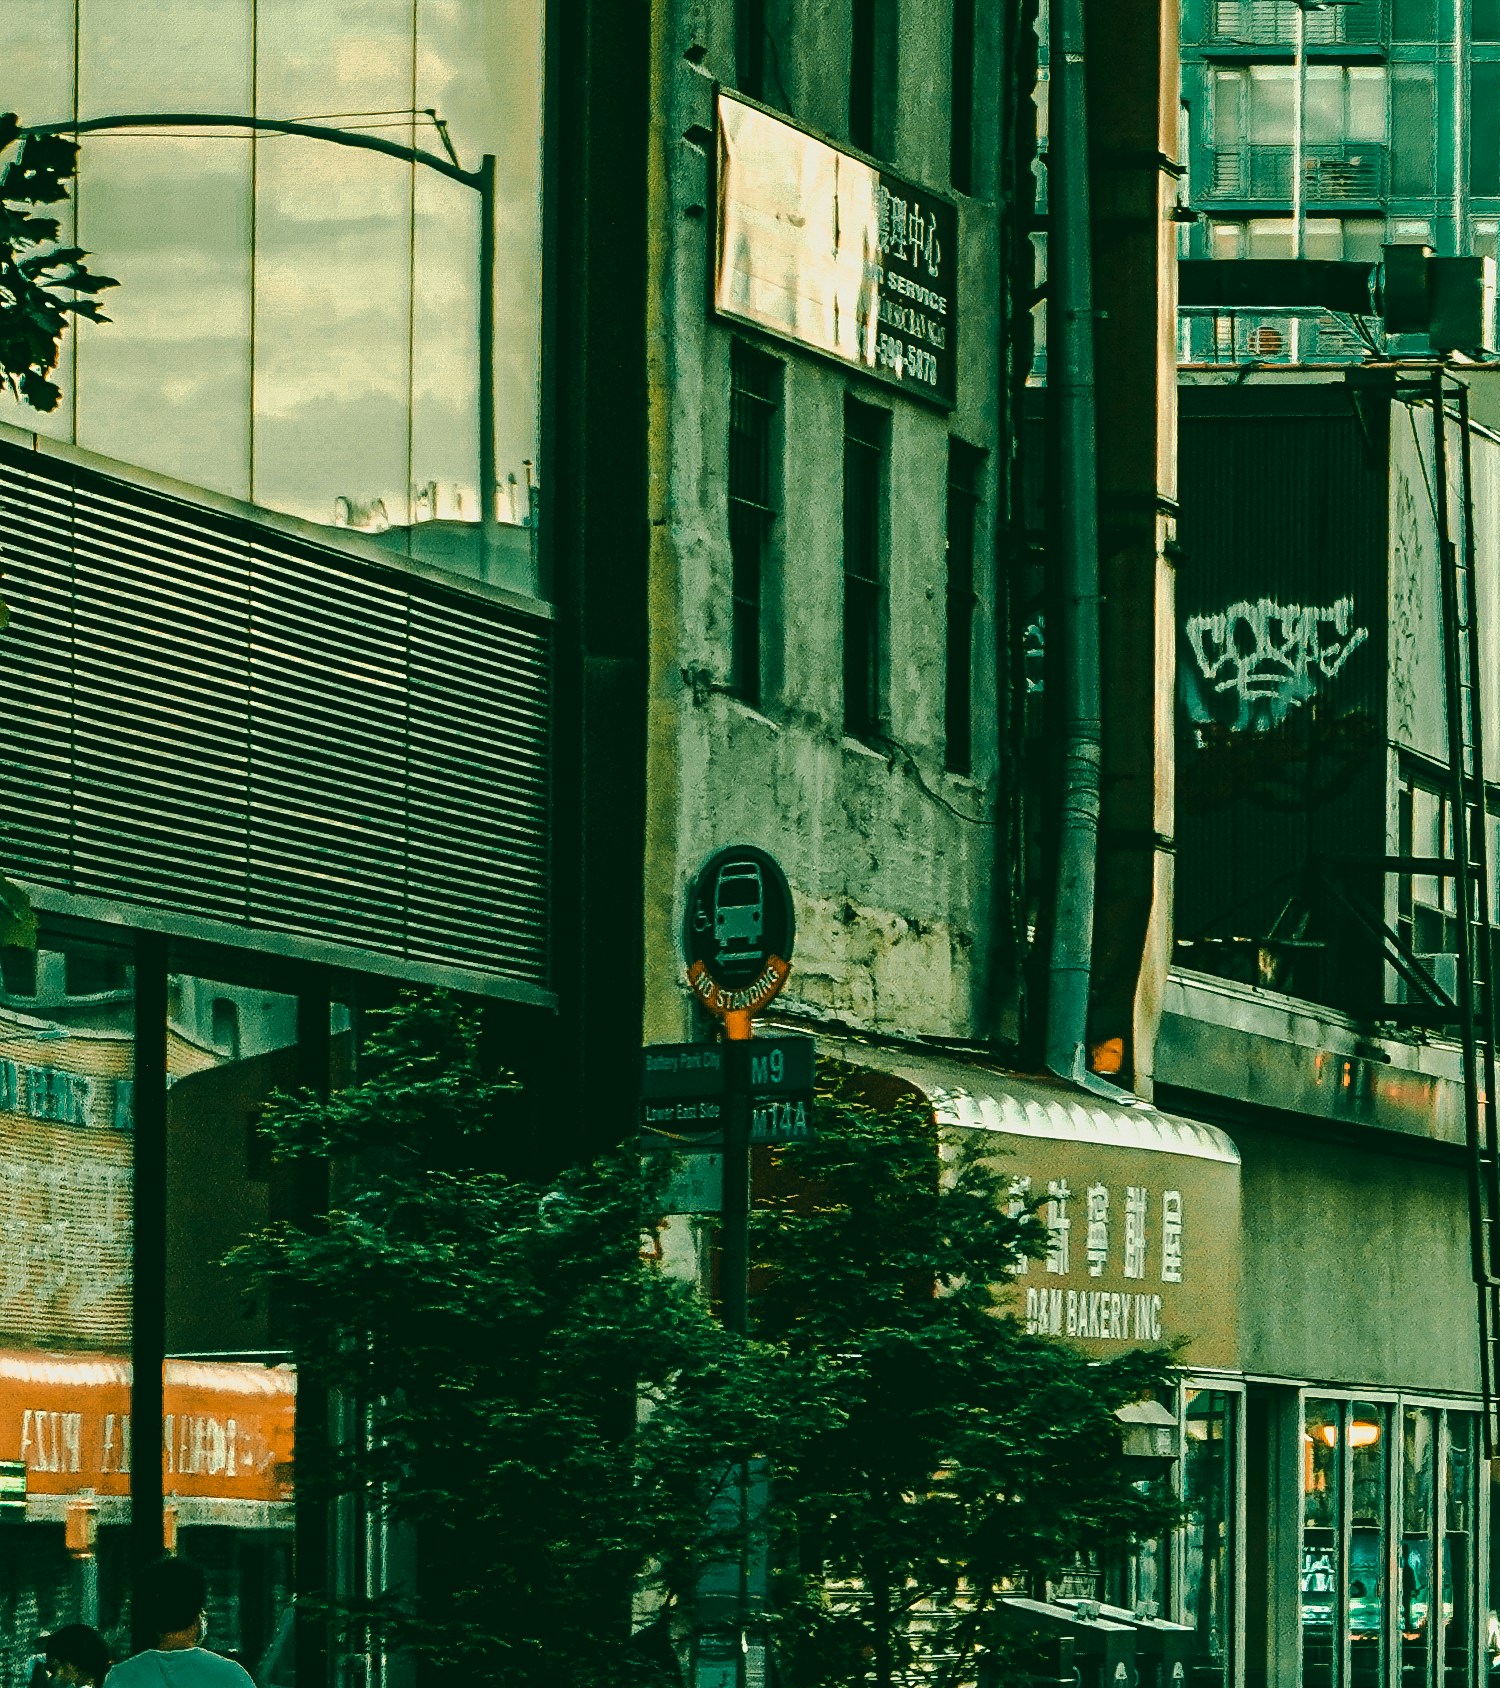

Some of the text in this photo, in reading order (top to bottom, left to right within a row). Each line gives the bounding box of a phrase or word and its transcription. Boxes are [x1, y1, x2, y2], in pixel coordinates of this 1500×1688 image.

[888, 271, 948, 315] SERVICE
[696, 965, 780, 1009] NO STANDING
[752, 1049, 784, 1084] M9
[646, 1102, 720, 1121] Lower East Side
[753, 1101, 808, 1138] M14A
[1066, 1290, 1131, 1339] BAKERY
[1134, 1293, 1162, 1340] INC
